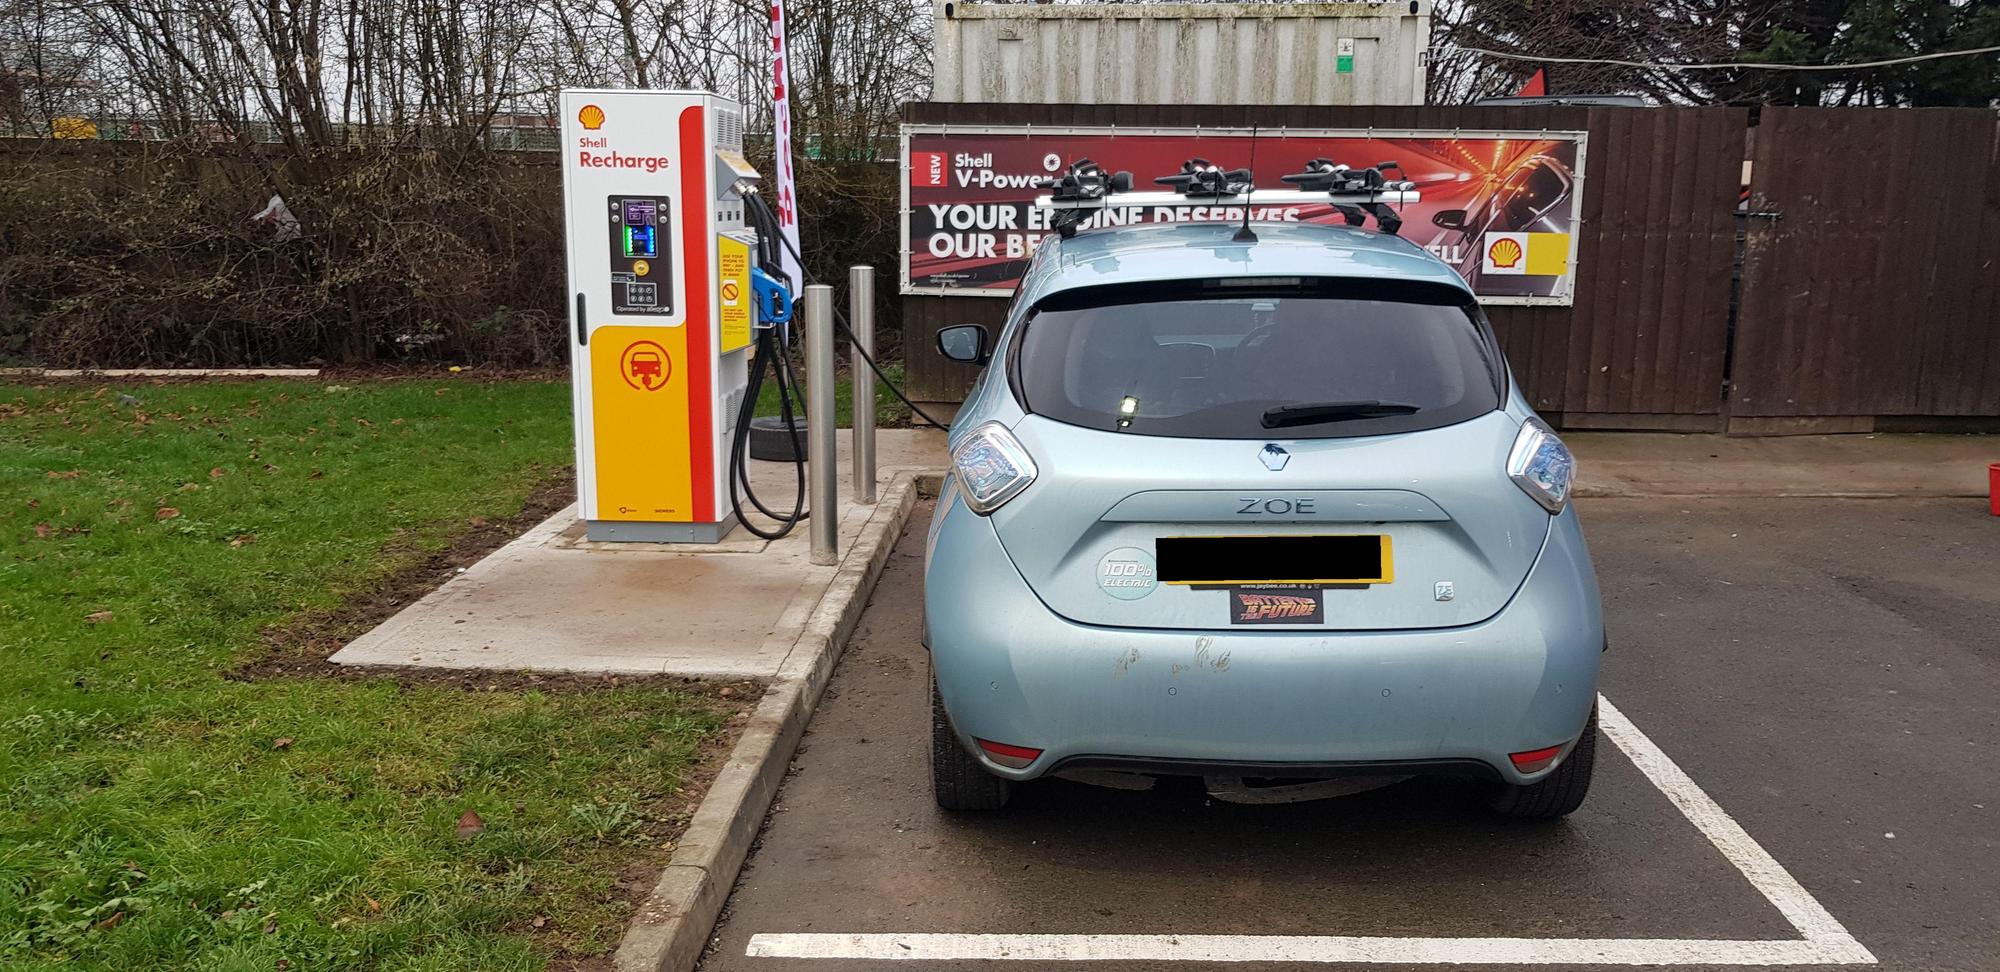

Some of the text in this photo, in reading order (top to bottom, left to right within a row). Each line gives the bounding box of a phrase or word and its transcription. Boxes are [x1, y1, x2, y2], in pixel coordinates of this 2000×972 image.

[579, 137, 607, 148] Shell
[579, 150, 669, 173] Recharge
[955, 152, 993, 168] Shell
[930, 154, 941, 185] NEW
[928, 204, 1018, 230] YOUR
[928, 232, 997, 259] OUR
[1424, 244, 1464, 264] ELL
[1236, 497, 1316, 515] ZOE
[1104, 564, 1152, 577] 100%
[1103, 578, 1153, 588] ELECTRIC
[1258, 604, 1317, 619] FUTURE
